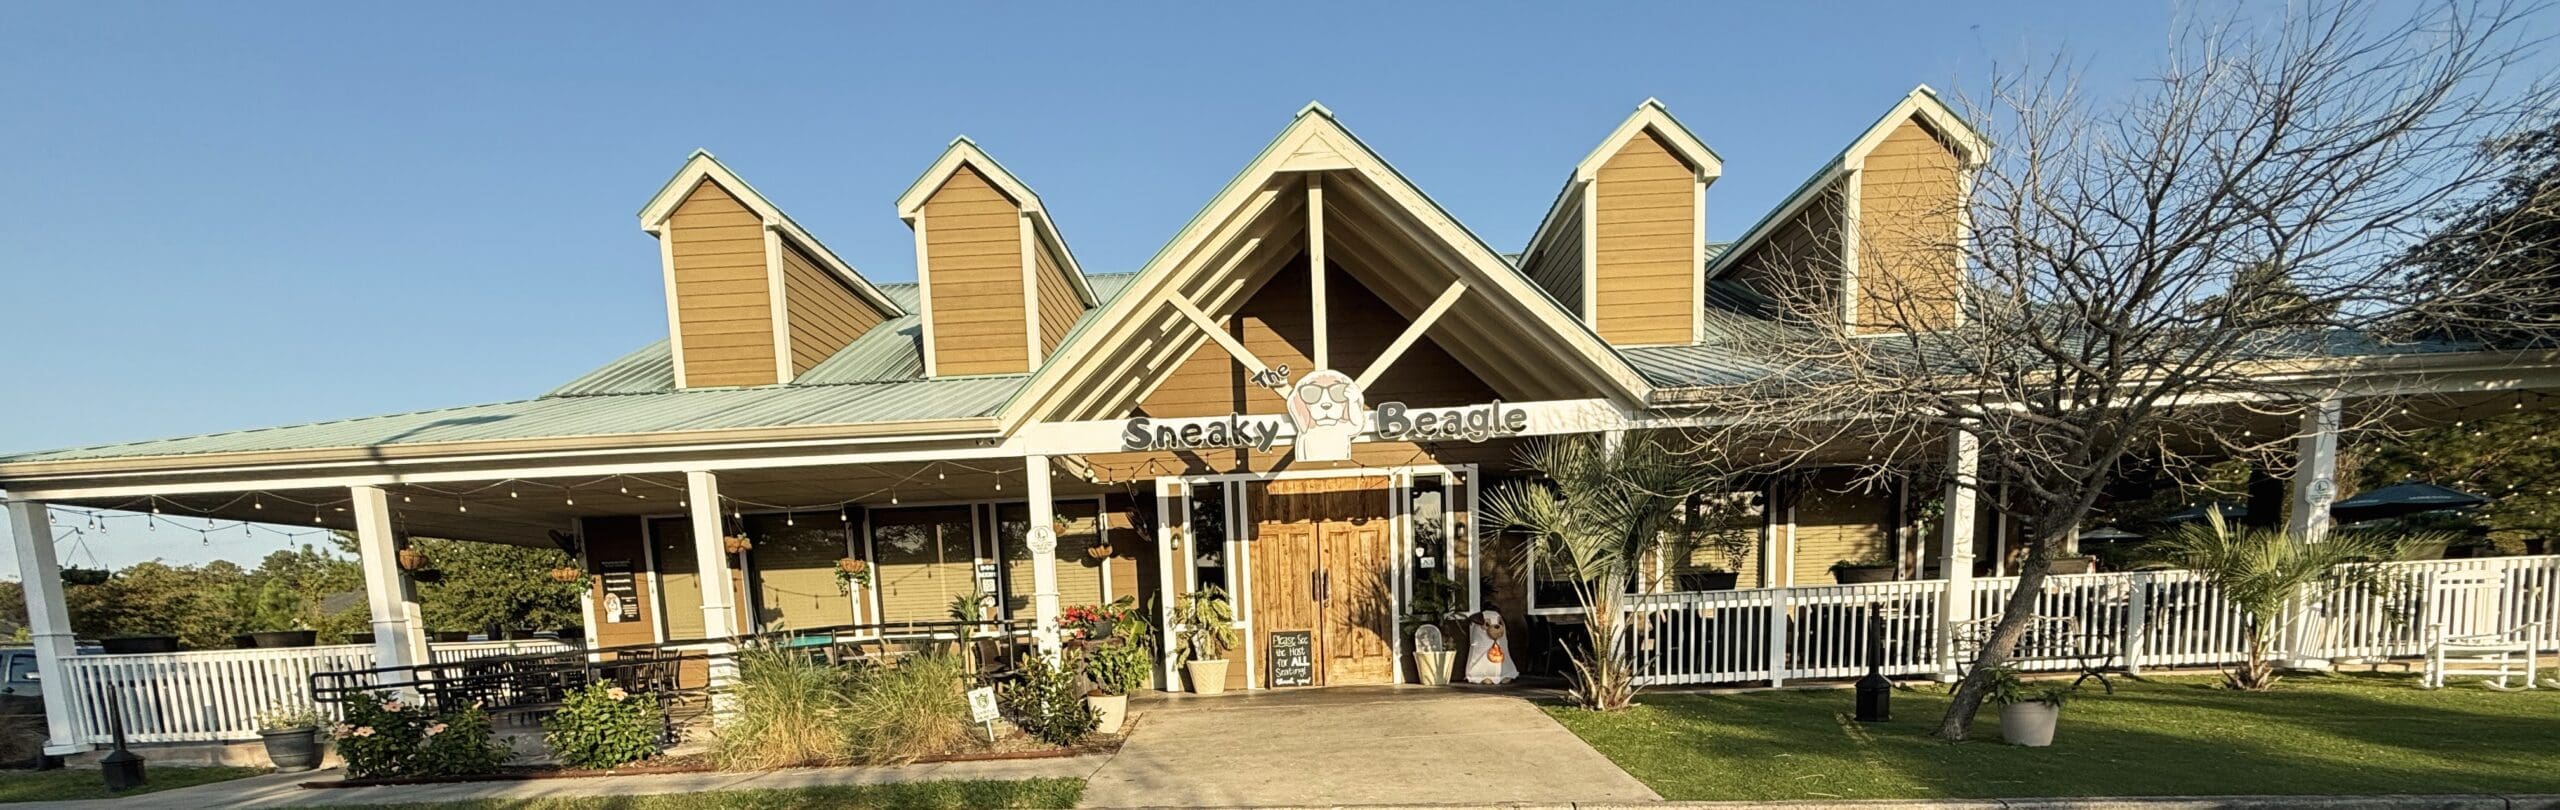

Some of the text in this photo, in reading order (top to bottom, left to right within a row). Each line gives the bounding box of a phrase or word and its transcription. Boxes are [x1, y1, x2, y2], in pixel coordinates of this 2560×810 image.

[1250, 364, 1290, 389] The
[1125, 399, 1528, 453] Sneaky Beagle
[1272, 634, 1309, 645] Please See
[1275, 646, 1306, 657] the Host
[1277, 656, 1310, 668] for ALL
